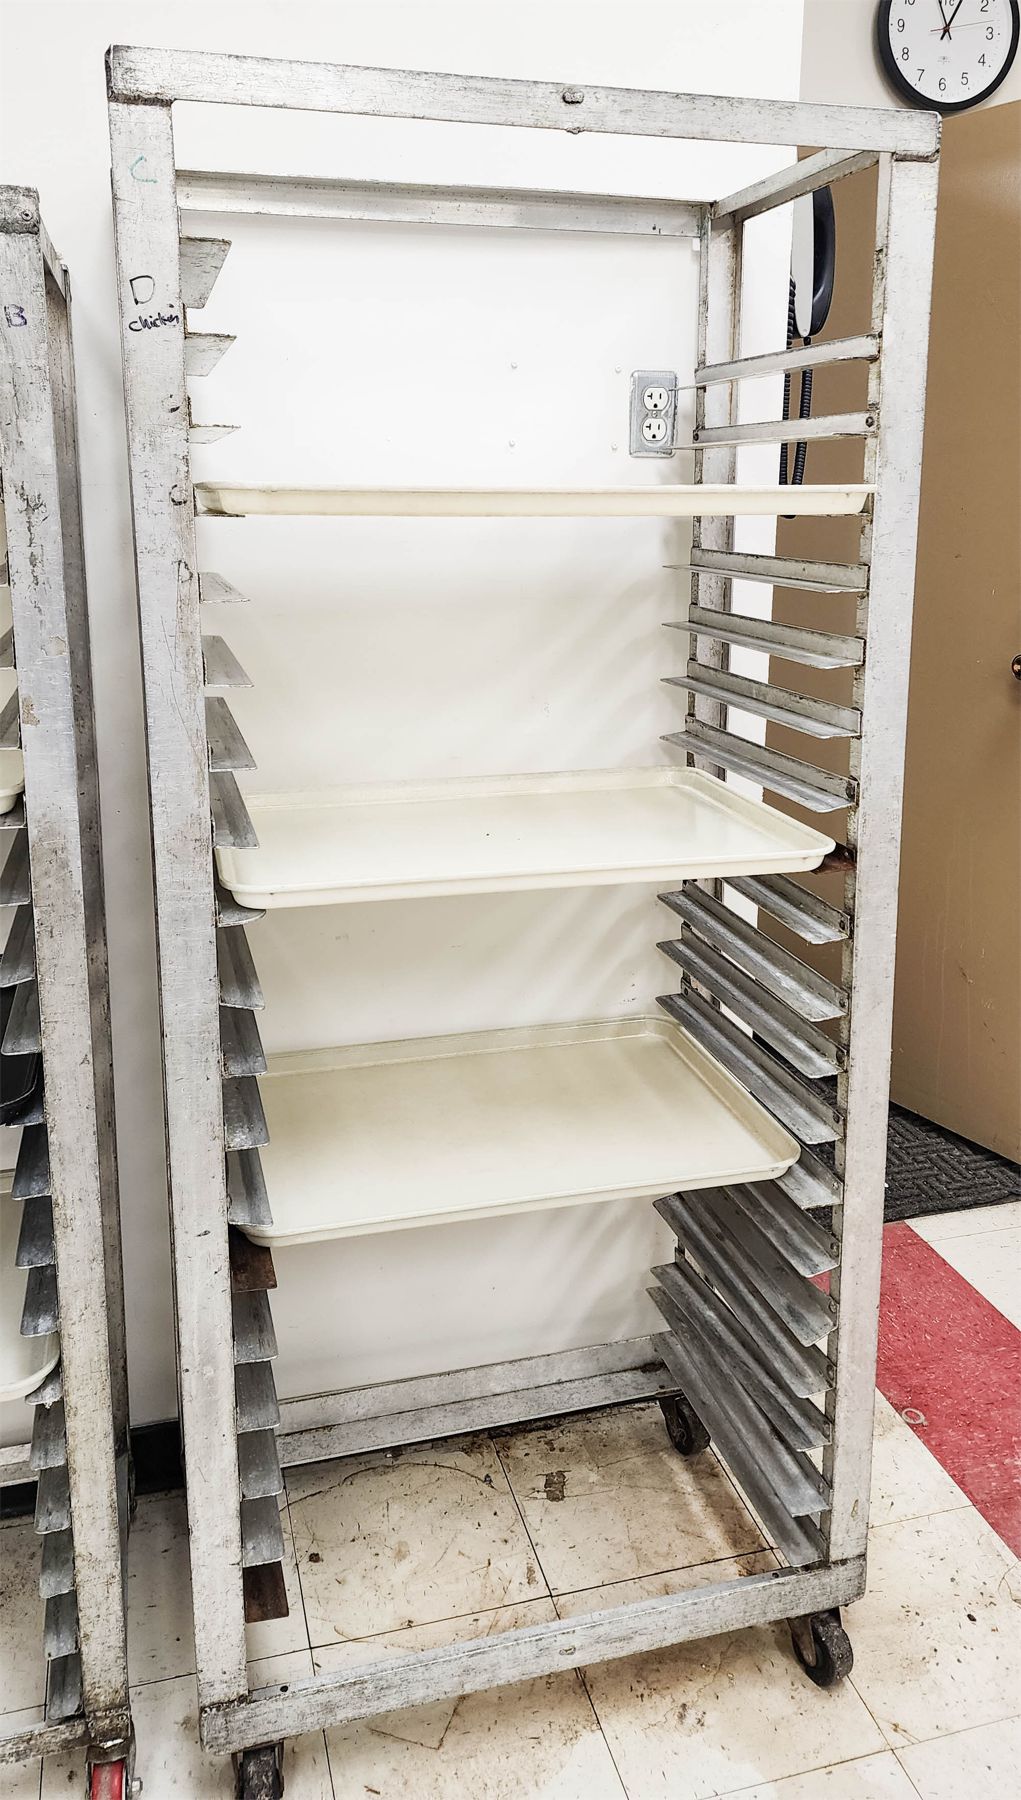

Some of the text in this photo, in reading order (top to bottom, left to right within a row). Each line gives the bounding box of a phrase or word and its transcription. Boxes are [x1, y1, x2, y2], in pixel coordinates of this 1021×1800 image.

[980, 0, 989, 13] 2
[897, 18, 905, 33] 9
[985, 26, 994, 40] 3
[901, 47, 910, 61] 8
[977, 53, 986, 66] 4
[917, 68, 925, 82] 7
[960, 72, 969, 86] 5
[938, 77, 947, 91] 6
[129, 154, 159, 184] C
[128, 274, 156, 305] D
[3, 303, 28, 328] B
